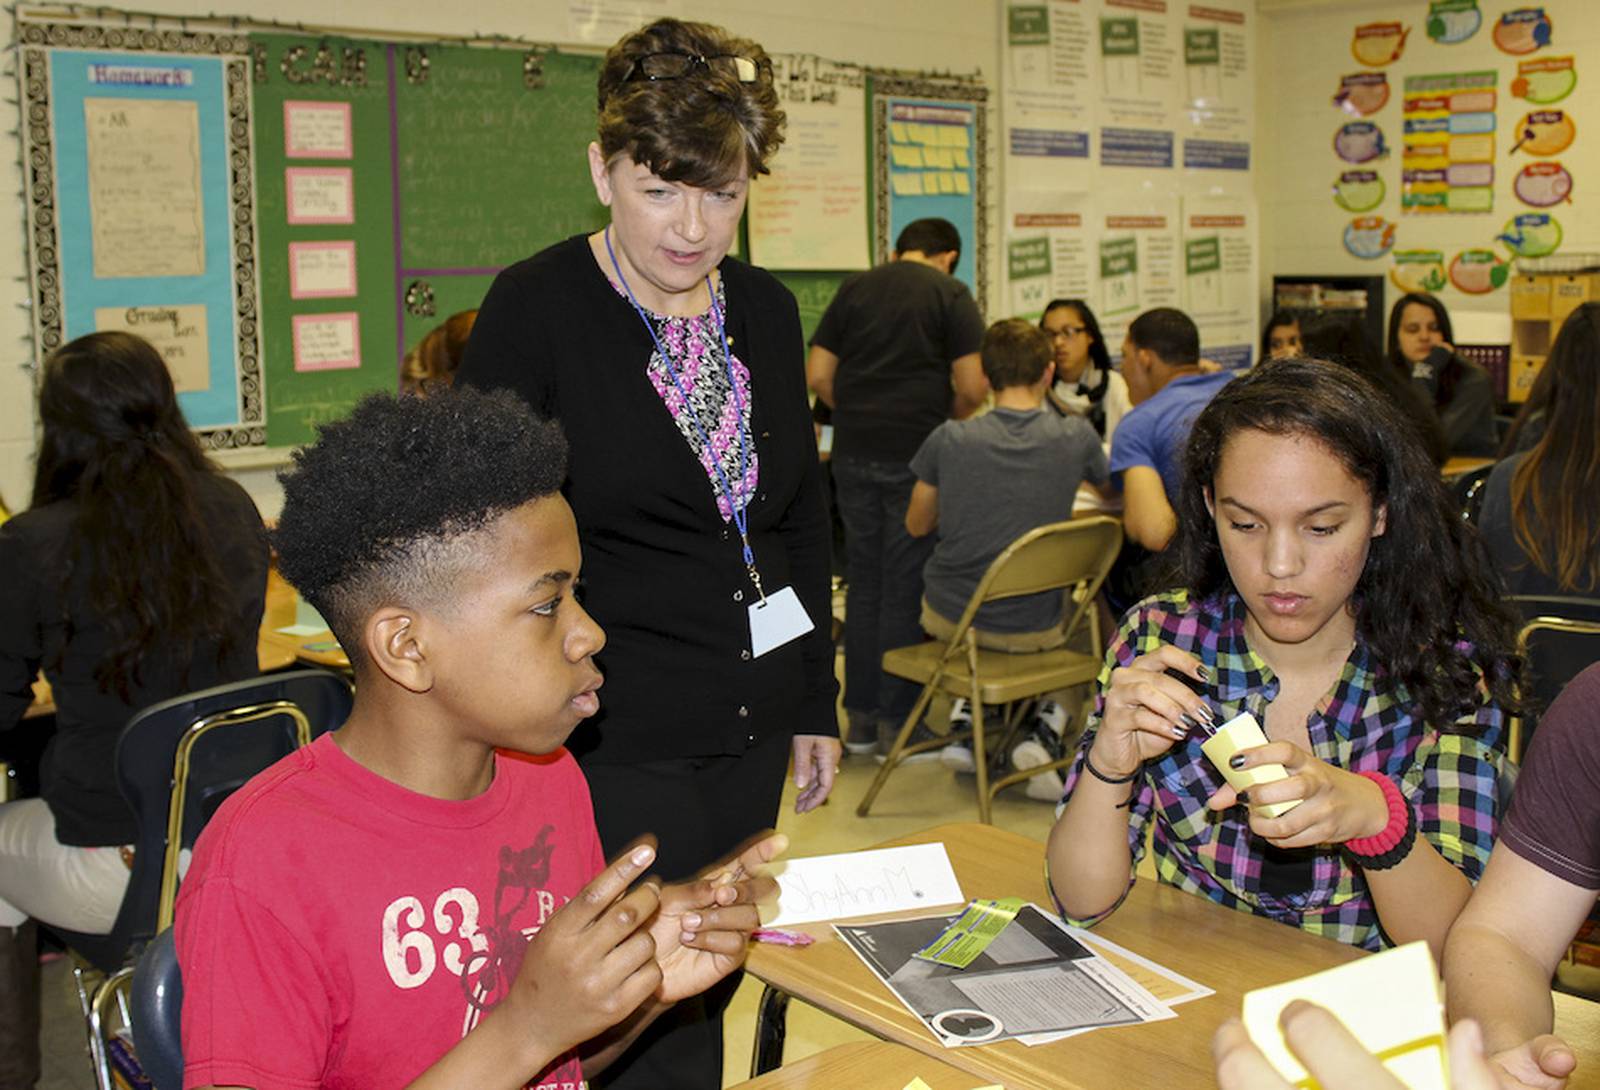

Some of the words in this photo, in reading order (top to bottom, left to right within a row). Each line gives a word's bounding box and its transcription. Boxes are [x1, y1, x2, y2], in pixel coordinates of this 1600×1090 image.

[95, 63, 185, 87] Homework
[254, 43, 268, 83] I
[383, 887, 489, 989] 63
